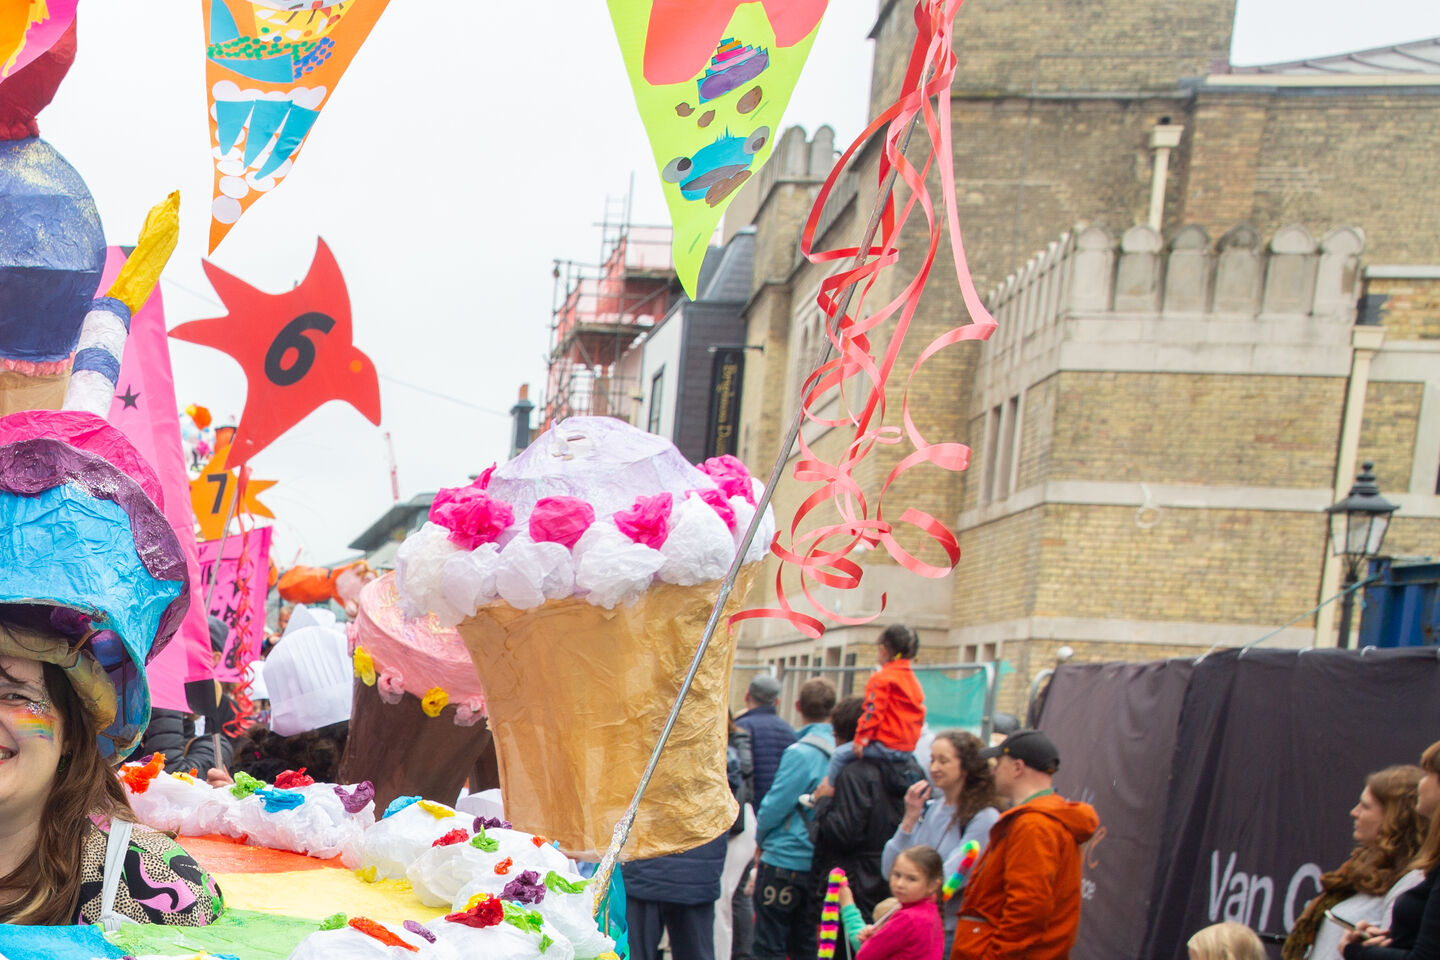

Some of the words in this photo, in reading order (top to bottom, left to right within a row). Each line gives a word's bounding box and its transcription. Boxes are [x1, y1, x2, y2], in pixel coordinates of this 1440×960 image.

[263, 311, 336, 387] 6
[207, 472, 228, 515] 7
[763, 885, 793, 905] 96
[1207, 849, 1274, 933] Van
